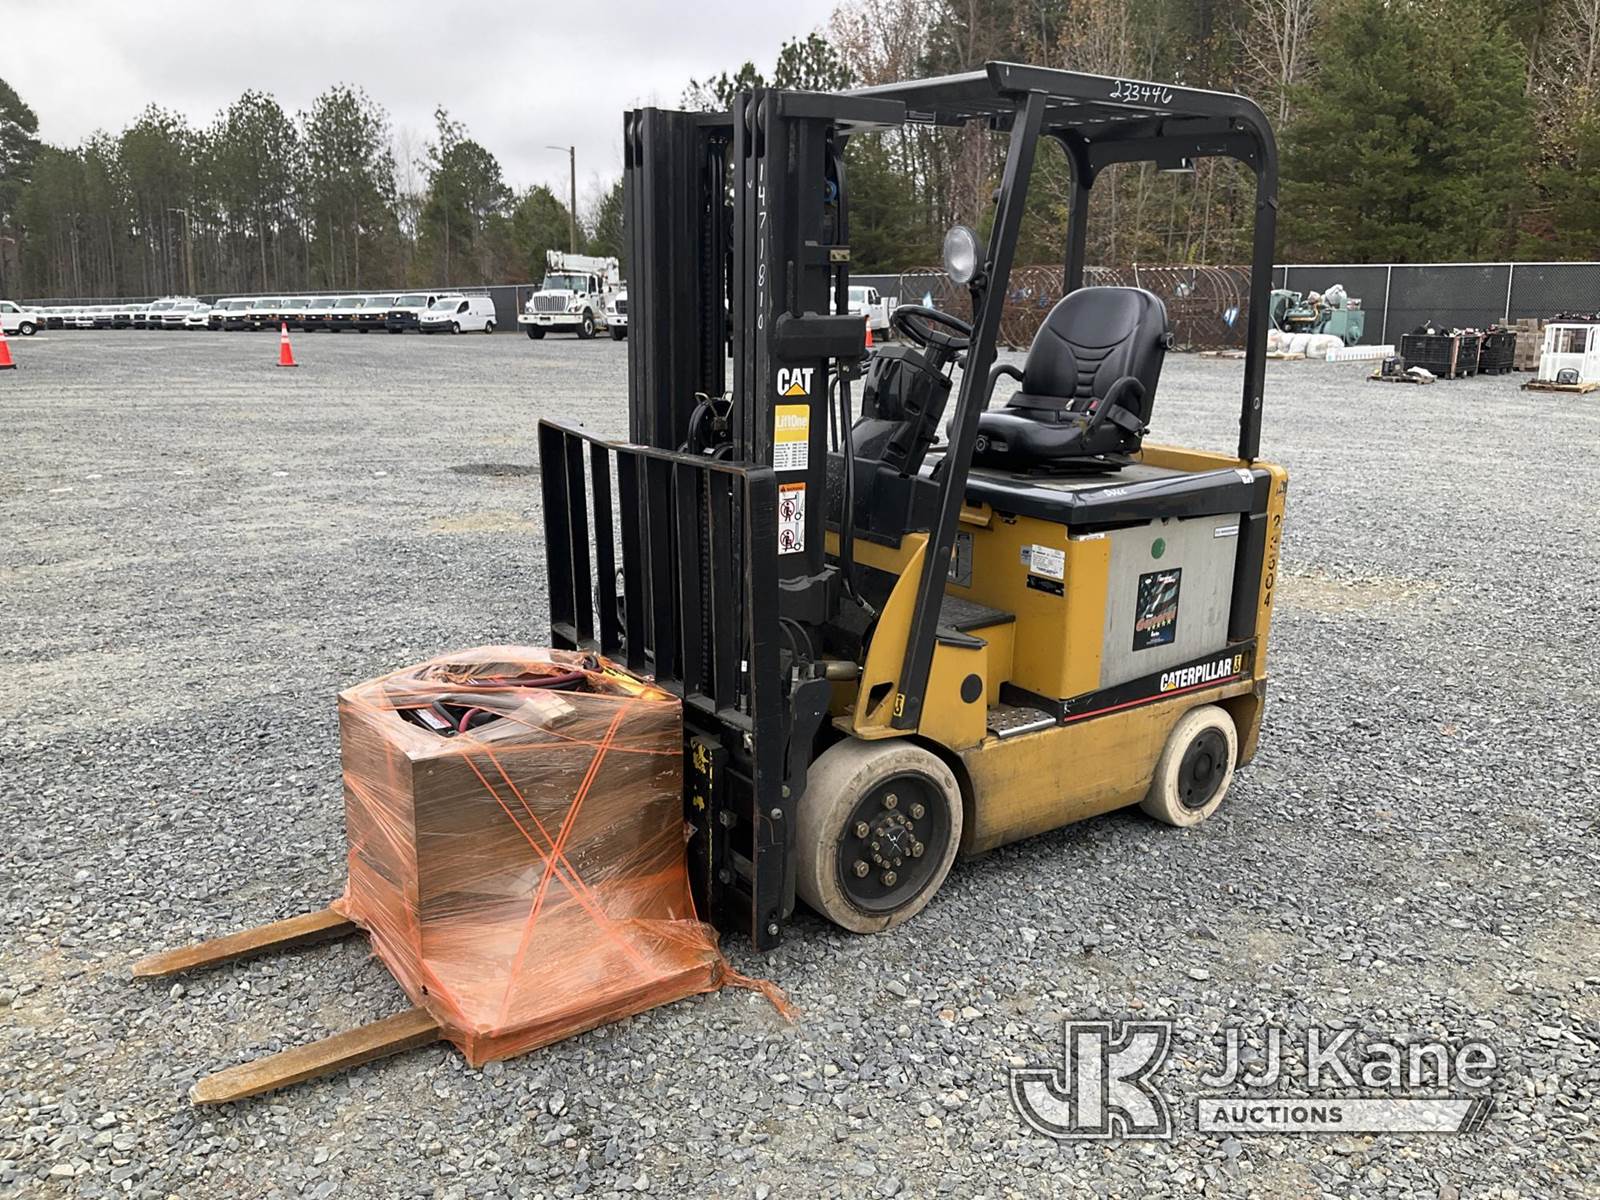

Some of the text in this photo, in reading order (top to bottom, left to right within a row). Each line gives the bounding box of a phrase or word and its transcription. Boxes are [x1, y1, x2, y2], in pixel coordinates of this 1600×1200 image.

[1109, 80, 1173, 104] 233446
[777, 367, 814, 396] CAT
[1160, 658, 1232, 692] CATERPILLAR
